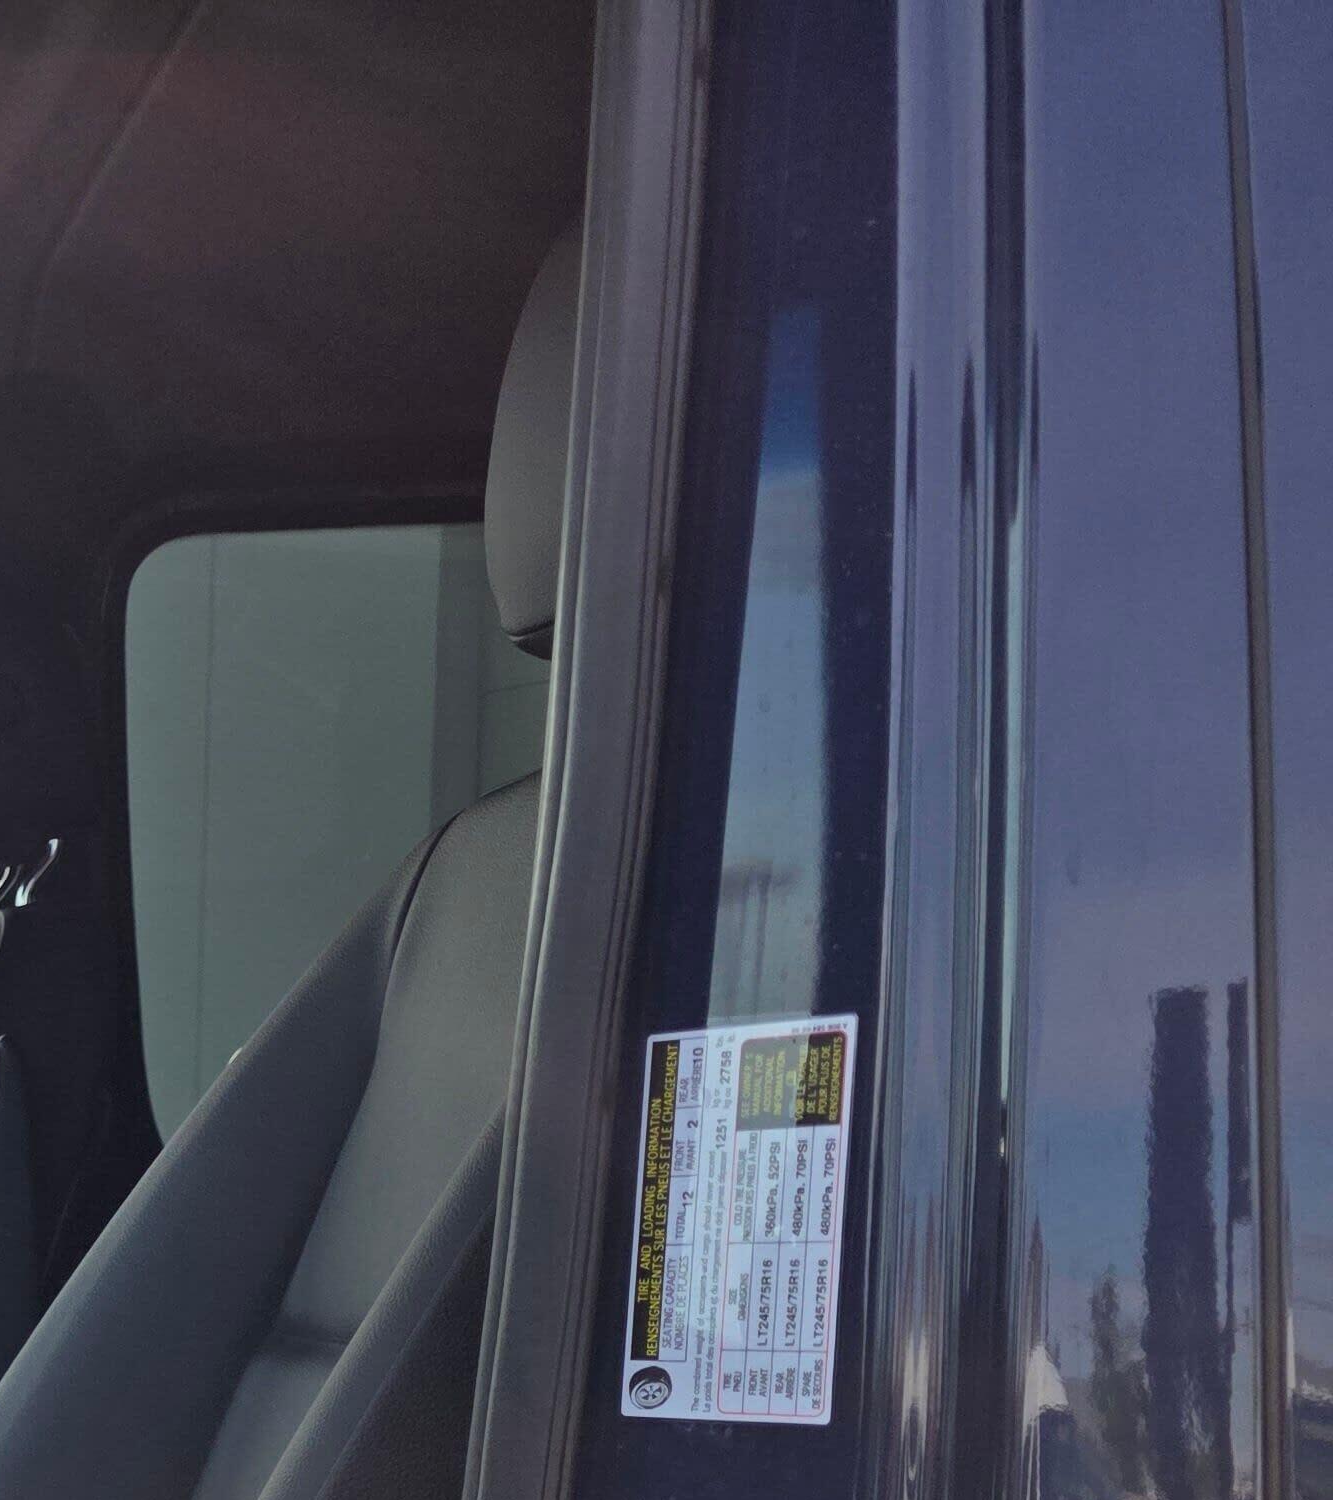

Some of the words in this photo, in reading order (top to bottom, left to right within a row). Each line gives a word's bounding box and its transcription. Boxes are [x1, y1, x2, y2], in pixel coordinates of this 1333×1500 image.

[692, 1047, 703, 1063] 10
[821, 1045, 830, 1058] DE
[719, 1050, 732, 1084] 2758
[819, 1060, 829, 1084] PLUS
[828, 1036, 843, 1120] RENSEIGNEMENTS
[662, 1043, 678, 1122] CHARGEMENT
[678, 1077, 688, 1102] REAR
[817, 1086, 828, 1114] POUR
[646, 1097, 661, 1177] INFORMATION
[661, 1126, 672, 1140] LE
[687, 1119, 698, 1128] 2
[715, 1118, 727, 1148] 1251
[659, 1143, 671, 1158] ET
[673, 1139, 684, 1171] FRONT
[685, 1139, 696, 1170] AVANT
[767, 1141, 781, 1180] 52PSI
[795, 1139, 808, 1177] 70PSI
[823, 1137, 836, 1176] 70PSI
[656, 1161, 669, 1200] PNEUS
[642, 1185, 656, 1237] LOADING
[655, 1202, 667, 1222] LES
[681, 1191, 693, 1208] 12
[791, 1183, 805, 1236] 480kPa.
[819, 1182, 833, 1235] 480kPa.
[653, 1228, 665, 1250] SUR
[675, 1208, 686, 1240] TOTAL
[639, 1244, 651, 1269] AND
[664, 1258, 676, 1304] CAPACITY
[677, 1255, 689, 1291] PLACES
[637, 1278, 649, 1302] TIRE
[646, 1254, 663, 1355] RENSEIGNEMENTS
[676, 1295, 686, 1307] DE
[756, 1259, 773, 1346] LT245/75R16
[784, 1259, 800, 1346] LT245/75R16
[812, 1259, 828, 1347] LT245/75R16
[661, 1307, 673, 1348] SEATING
[673, 1311, 685, 1350] NOMBRE
[722, 1372, 731, 1389] TIRE
[732, 1371, 741, 1391] PNEU
[747, 1368, 758, 1395] FRONT
[758, 1367, 768, 1396] AVANT
[774, 1372, 783, 1393] REAR
[801, 1370, 811, 1396] SPARE
[812, 1358, 823, 1395] SECOURS
[690, 1397, 699, 1412] The
[811, 1397, 820, 1409] DE
